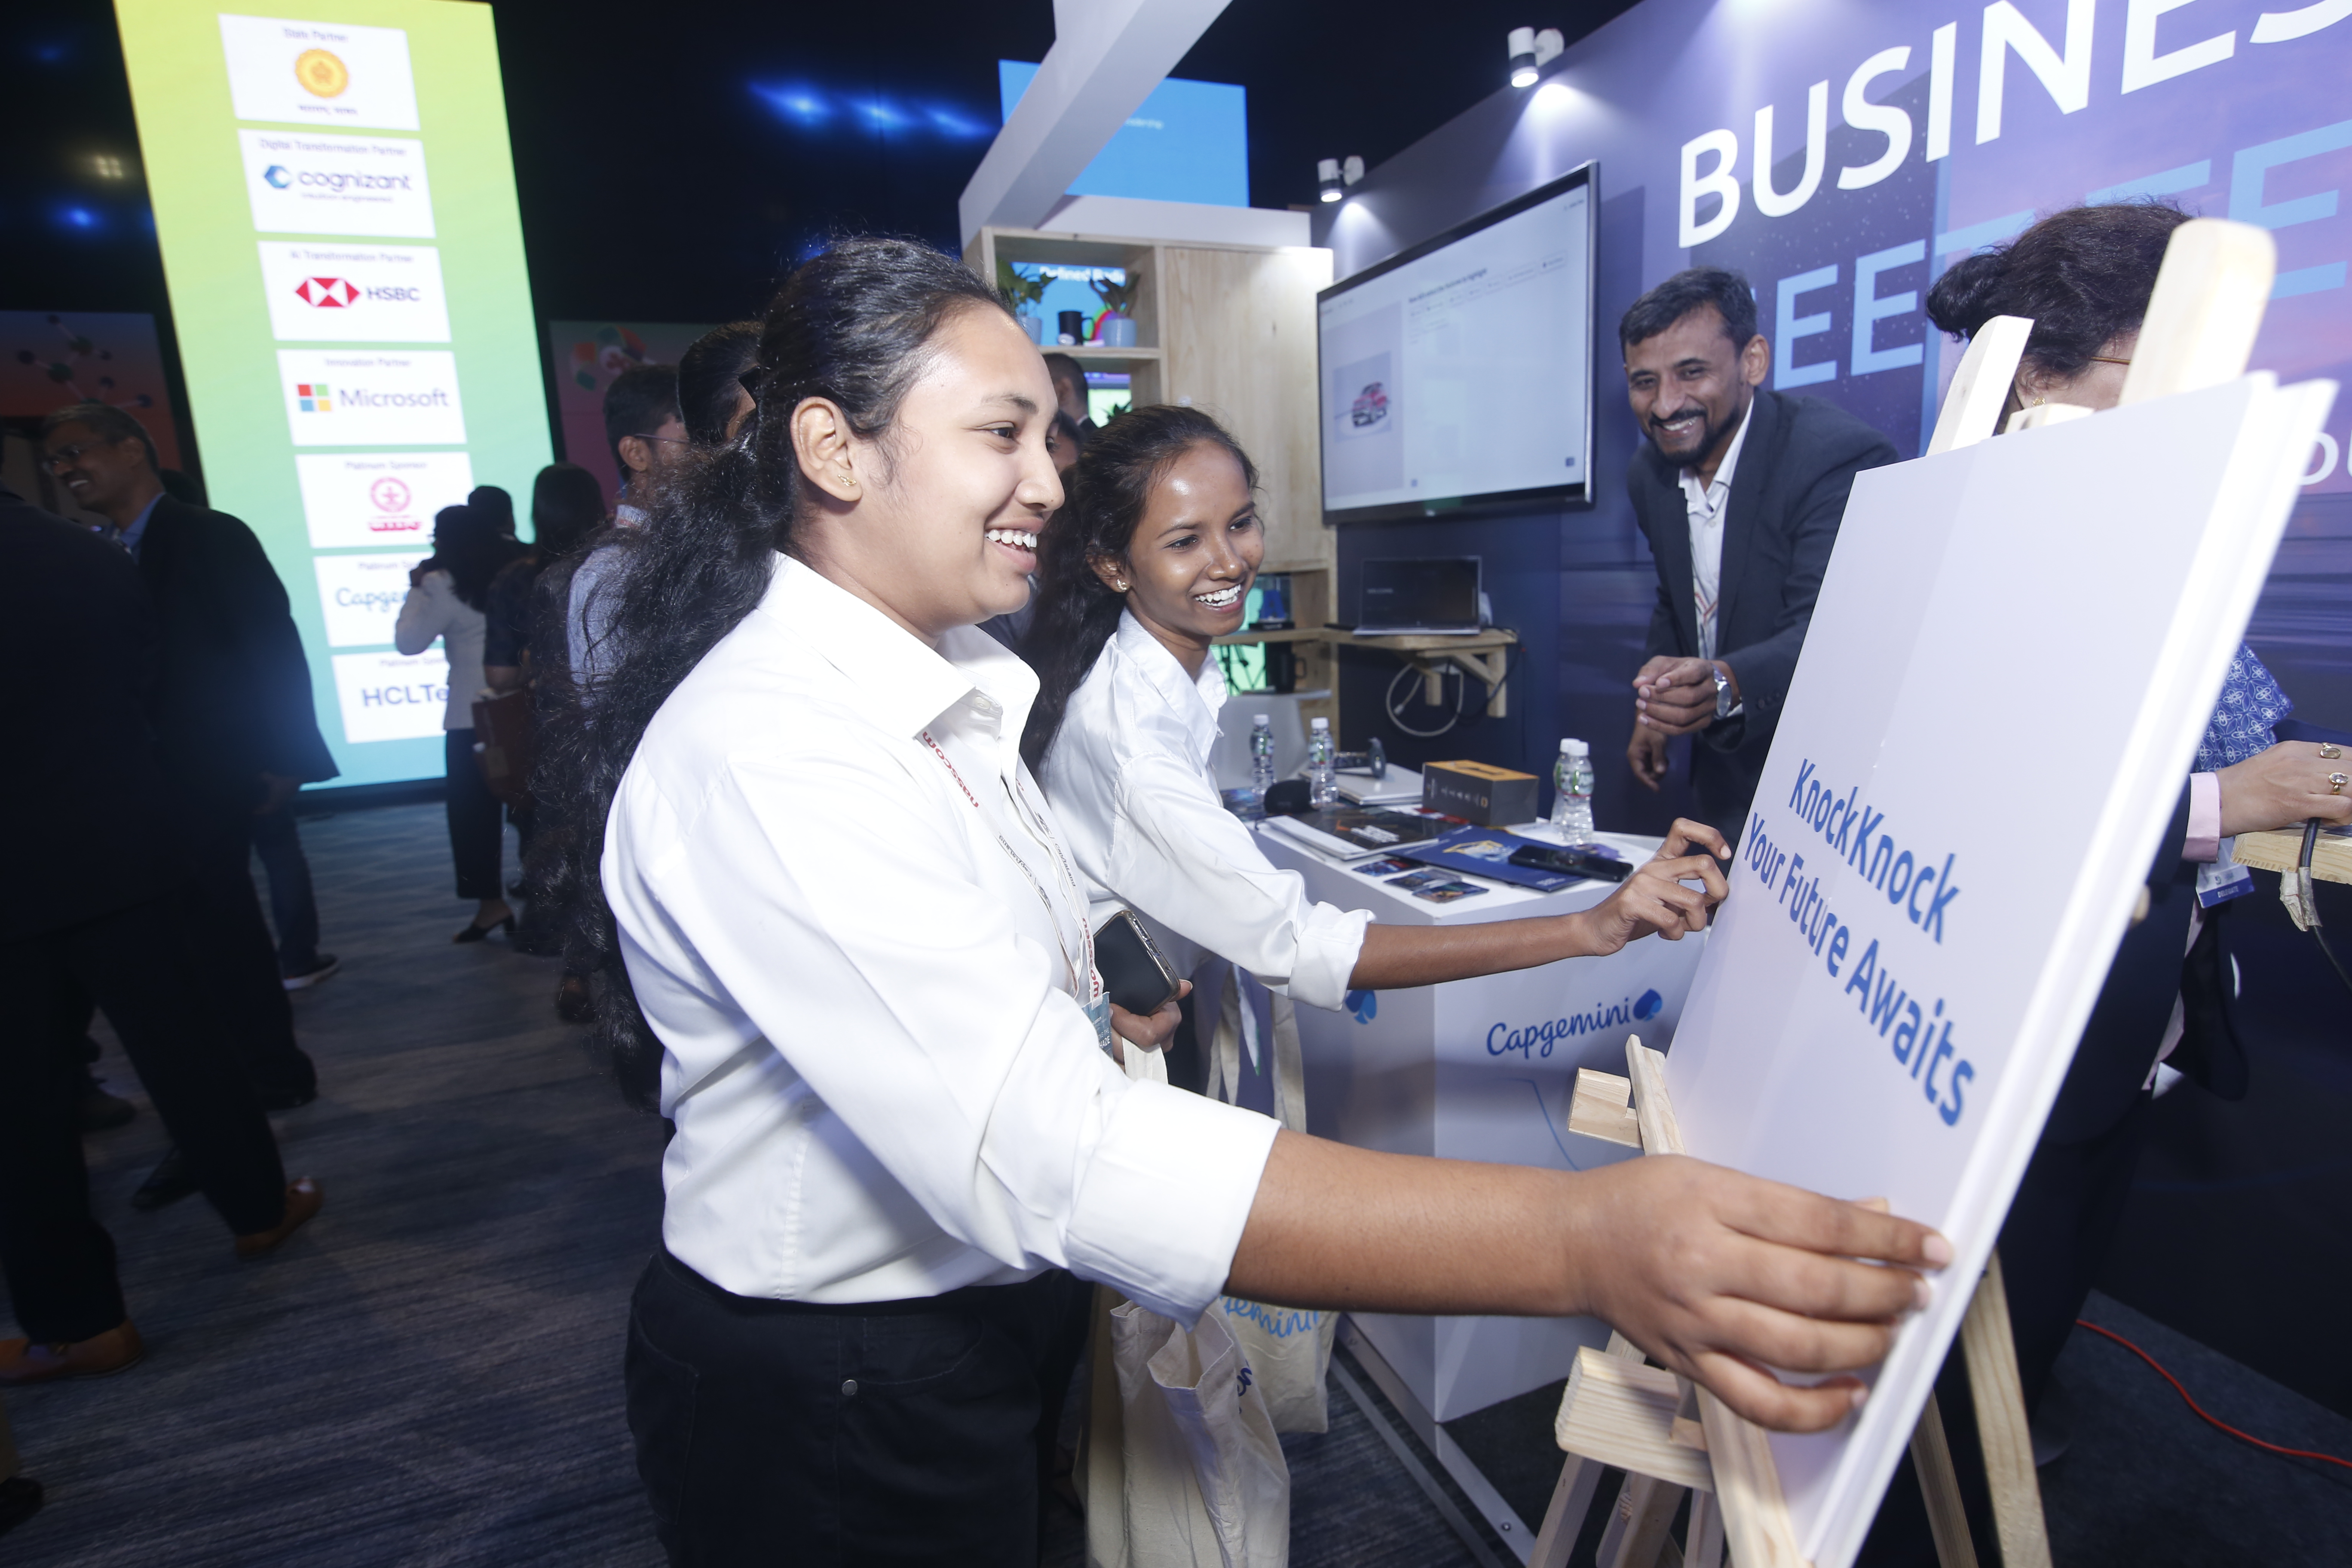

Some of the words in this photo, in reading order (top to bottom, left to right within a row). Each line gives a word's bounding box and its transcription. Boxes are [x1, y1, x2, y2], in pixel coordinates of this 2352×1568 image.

[294, 141, 368, 154] Transformation
[1678, 0, 2352, 248] BUSINE
[298, 170, 413, 193] cognizant
[303, 250, 376, 261] Transformation
[366, 287, 420, 301] HSBC
[338, 388, 449, 407] Microsoft
[922, 731, 979, 808] nasscom
[1788, 758, 1960, 945] KnockKnock
[1082, 917, 1100, 998] nasscom
[1743, 812, 1786, 890] Your
[1778, 852, 1850, 978] Future
[1844, 938, 1975, 1127] Awaits
[1486, 997, 1631, 1060] Capgemini
